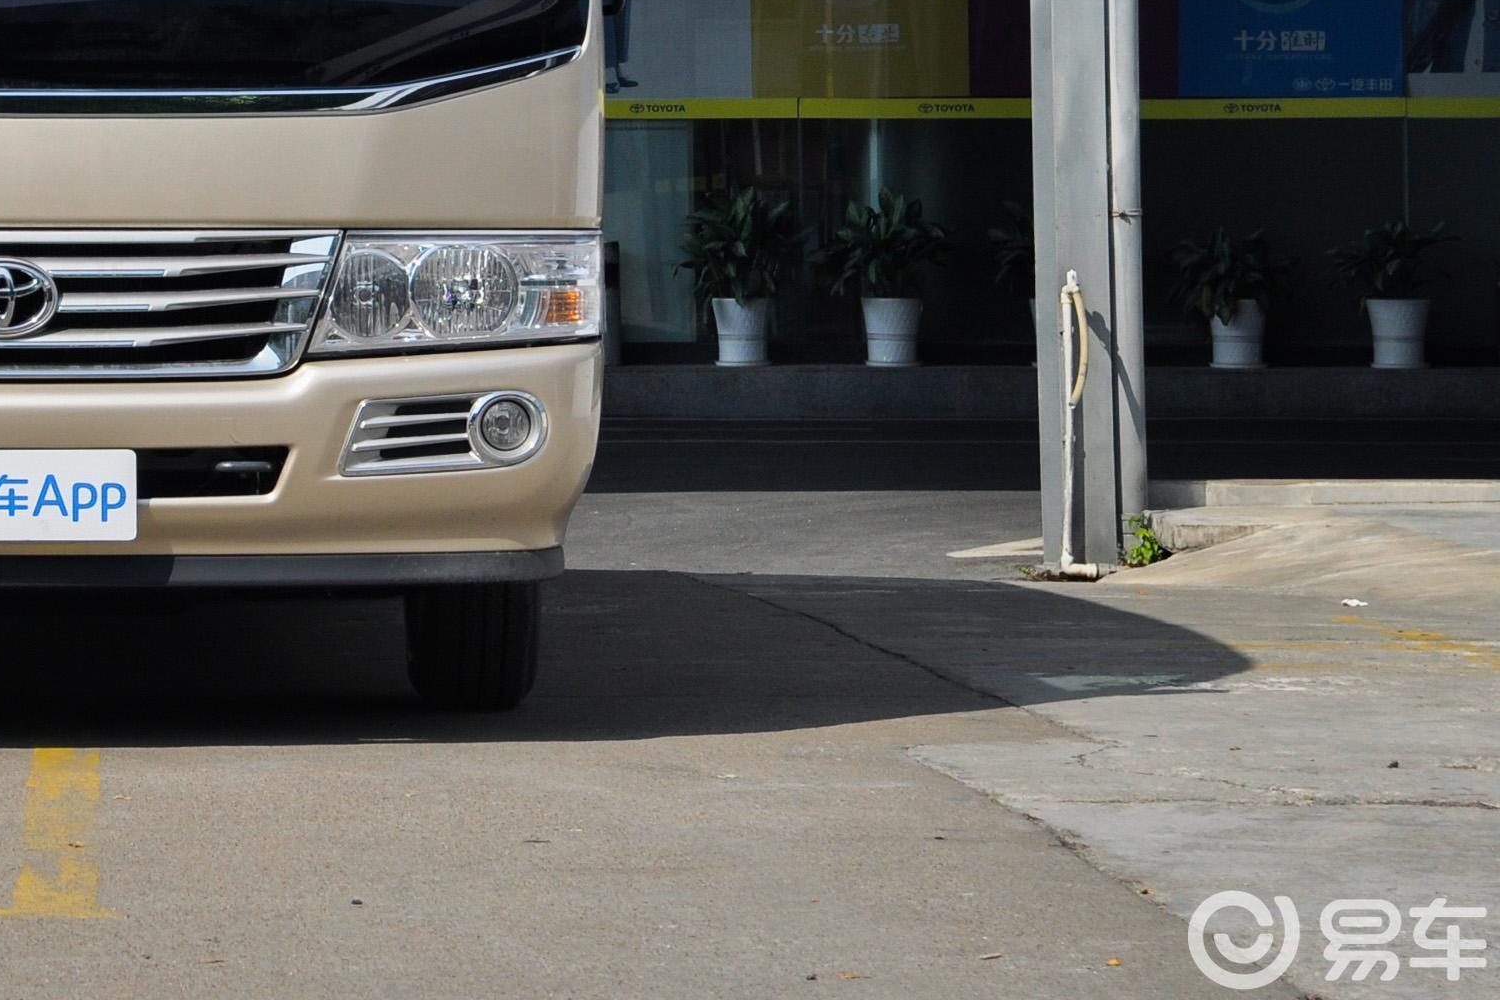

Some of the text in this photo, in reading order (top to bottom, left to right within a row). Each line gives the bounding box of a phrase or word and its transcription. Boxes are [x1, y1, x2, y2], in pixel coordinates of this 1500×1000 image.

[646, 104, 686, 113] TOYOTA
[935, 104, 975, 113] TOYOTA
[1240, 104, 1282, 113] TOYOTA
